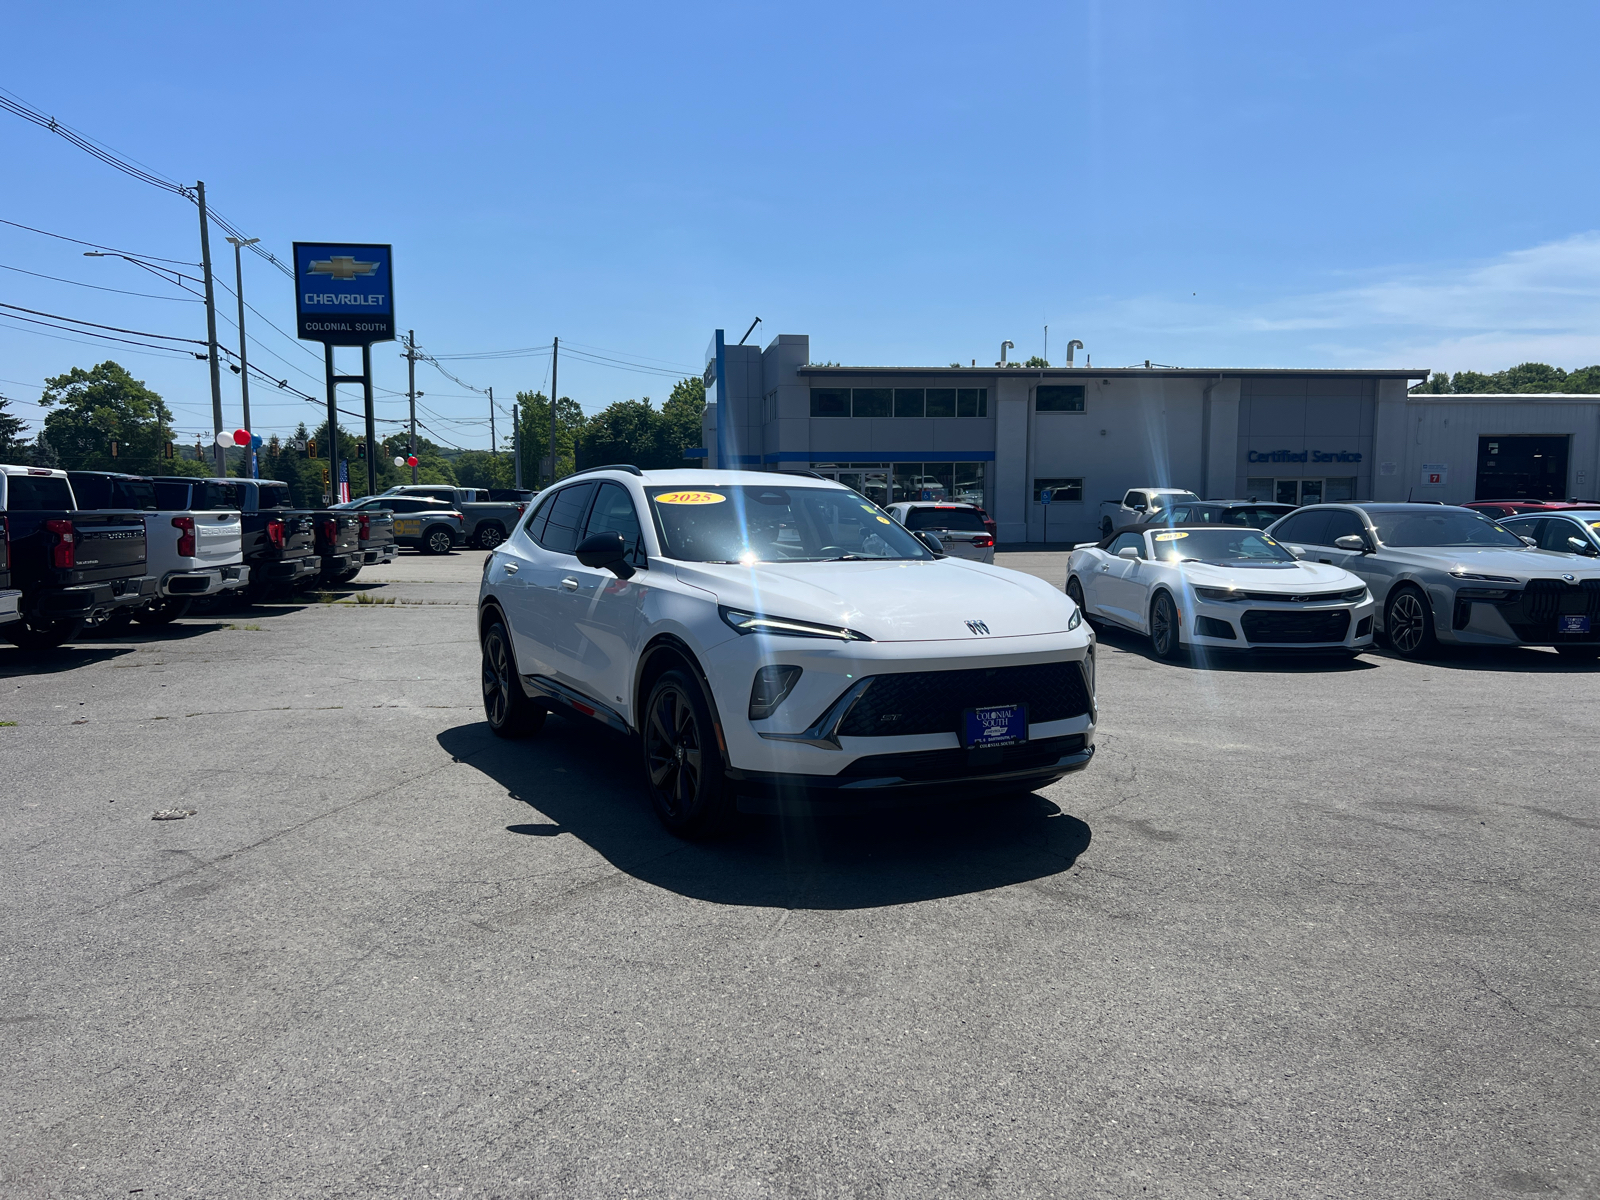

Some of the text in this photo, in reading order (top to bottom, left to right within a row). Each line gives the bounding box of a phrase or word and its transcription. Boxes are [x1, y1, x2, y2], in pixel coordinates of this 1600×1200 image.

[305, 293, 385, 305] CHEVROLET
[305, 322, 387, 331] COLONIAL SOUTH
[1248, 450, 1362, 463] Certified Service
[668, 493, 712, 502] 2025
[394, 520, 404, 535] 9
[976, 710, 1014, 721] COLONIAL
[982, 718, 1008, 727] SOUTH
